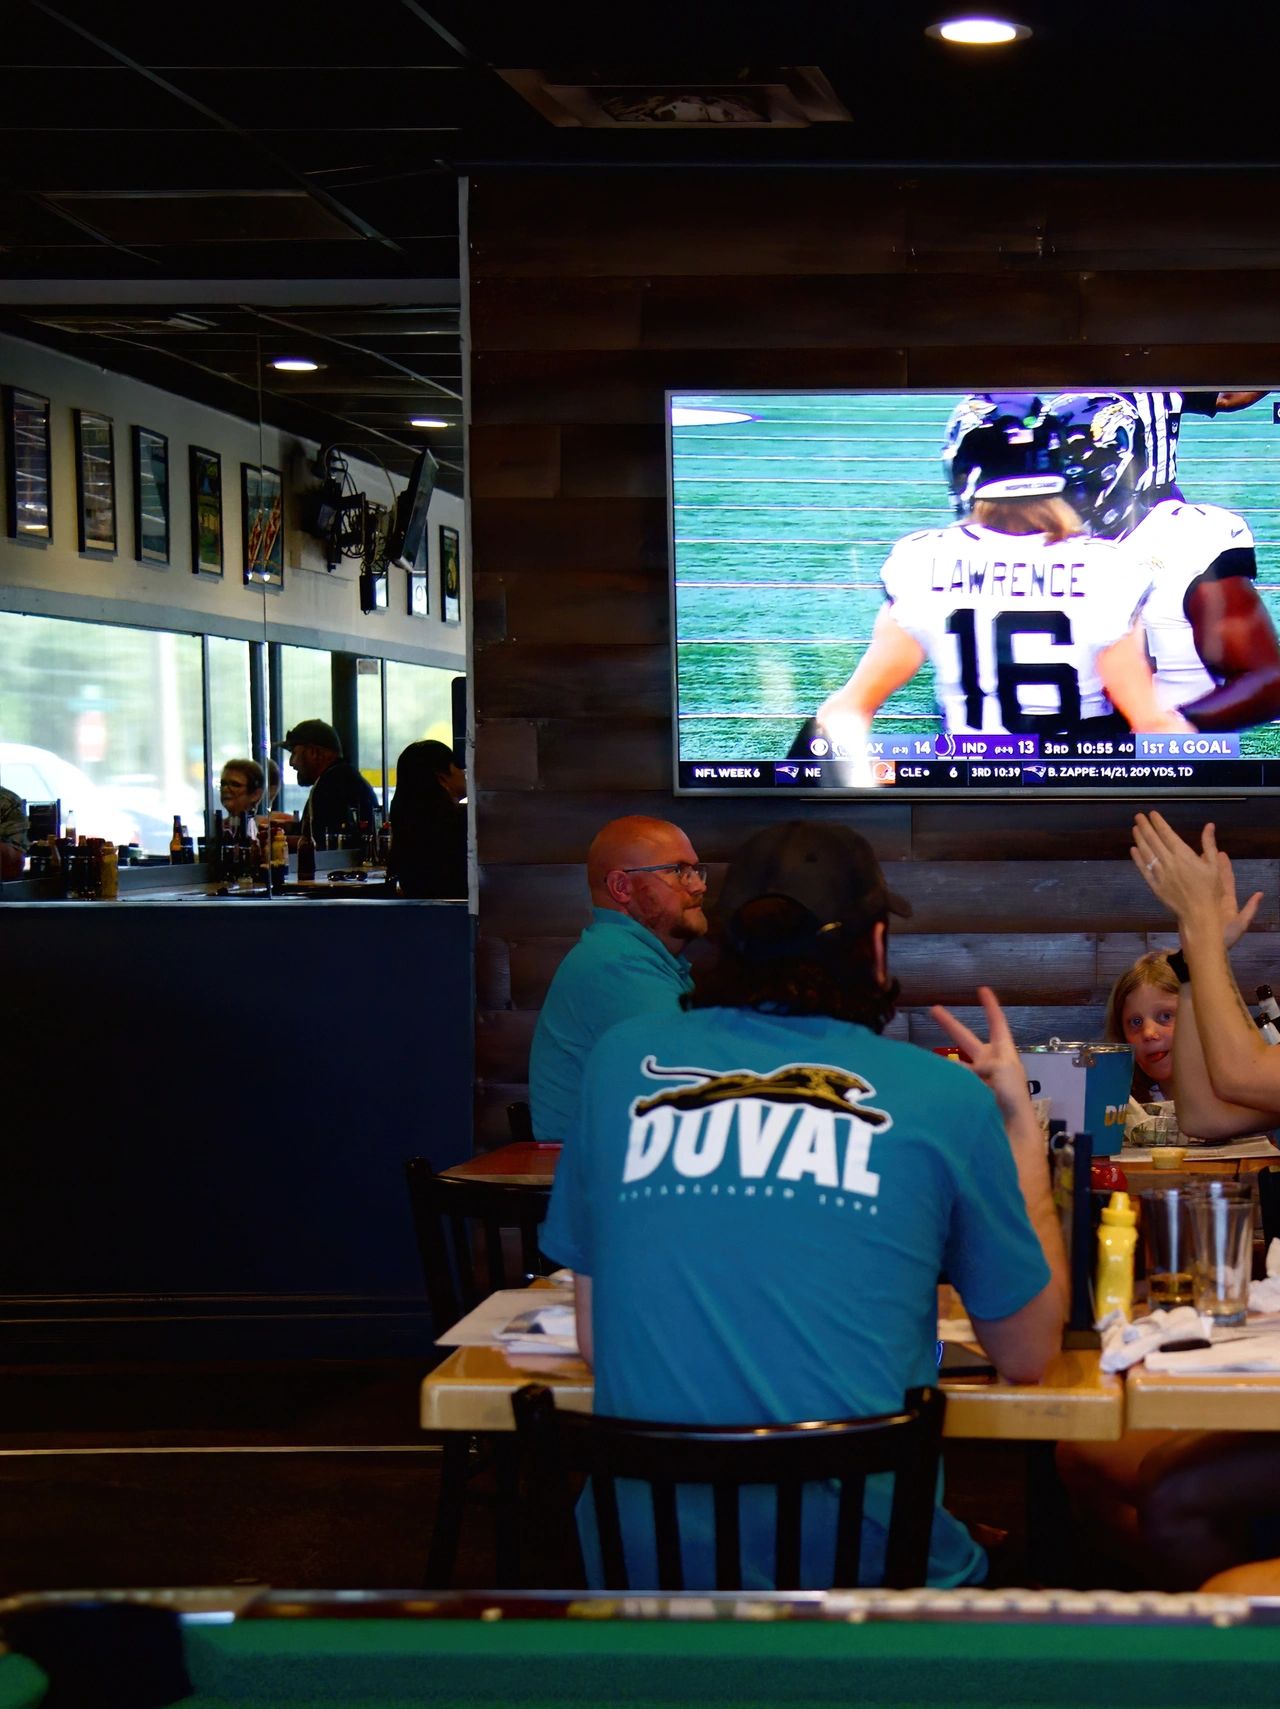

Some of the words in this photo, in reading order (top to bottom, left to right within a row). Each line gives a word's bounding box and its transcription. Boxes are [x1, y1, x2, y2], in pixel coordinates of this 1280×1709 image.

[930, 557, 1085, 598] LAWRENCE
[945, 608, 1081, 734] 16
[914, 740, 932, 754] 14
[962, 742, 988, 754] IND
[1018, 740, 1035, 754] 13
[1044, 742, 1069, 754] 3RD
[1076, 742, 1114, 754] 10:55
[1118, 743, 1134, 753] 40
[1142, 741, 1164, 755] 1ST
[1169, 741, 1179, 754] &
[1183, 741, 1231, 754] GOAL
[695, 768, 716, 778] NFL
[718, 768, 752, 778] WEEK
[753, 768, 760, 778] 6
[805, 768, 821, 777] NE
[900, 768, 922, 778] CLE
[949, 767, 958, 778] 6
[971, 768, 991, 777] 3RD
[994, 768, 1021, 777] 10:39
[1048, 767, 1059, 777] B.
[1060, 767, 1099, 777] ZAPPE:
[1100, 766, 1129, 779] 14/21,
[1130, 767, 1151, 777] 209
[1151, 766, 1178, 779] YDS,
[1178, 766, 1193, 777] TD
[622, 1098, 881, 1198] DUVAL
